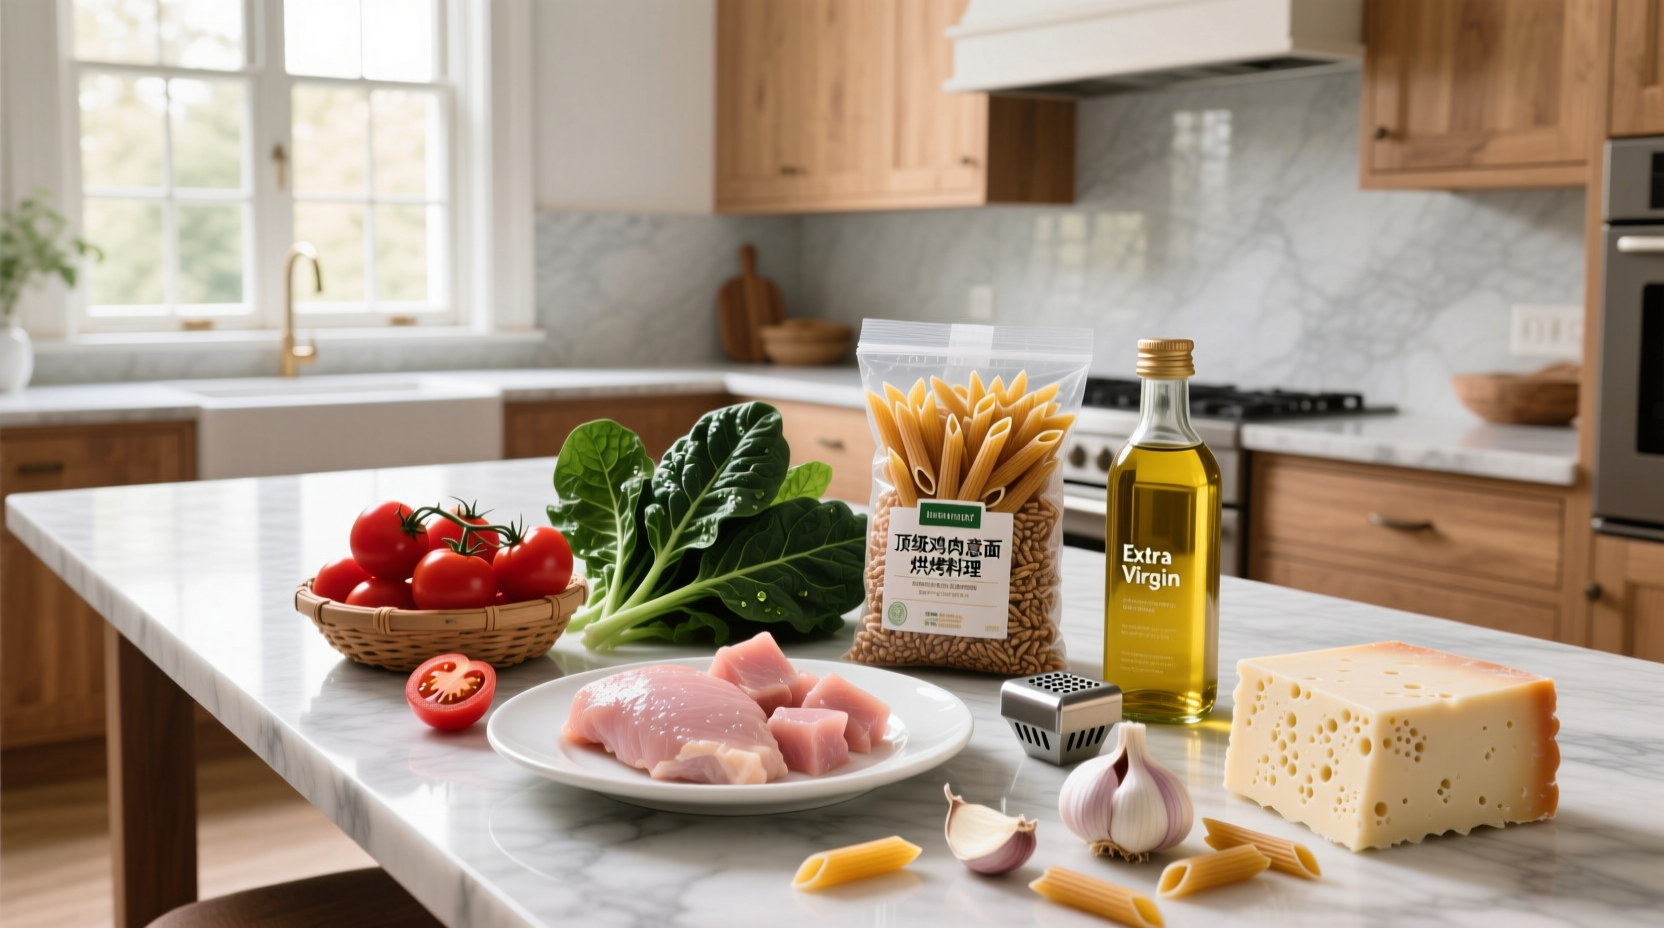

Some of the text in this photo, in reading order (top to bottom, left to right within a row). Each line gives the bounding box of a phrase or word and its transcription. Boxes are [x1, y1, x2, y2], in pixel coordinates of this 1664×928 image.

[894, 533, 1003, 559] 顶级鸡肉意面
[1123, 543, 1172, 565] Extra
[910, 555, 982, 578] 烘烤料理
[1122, 564, 1181, 591] Virgin
